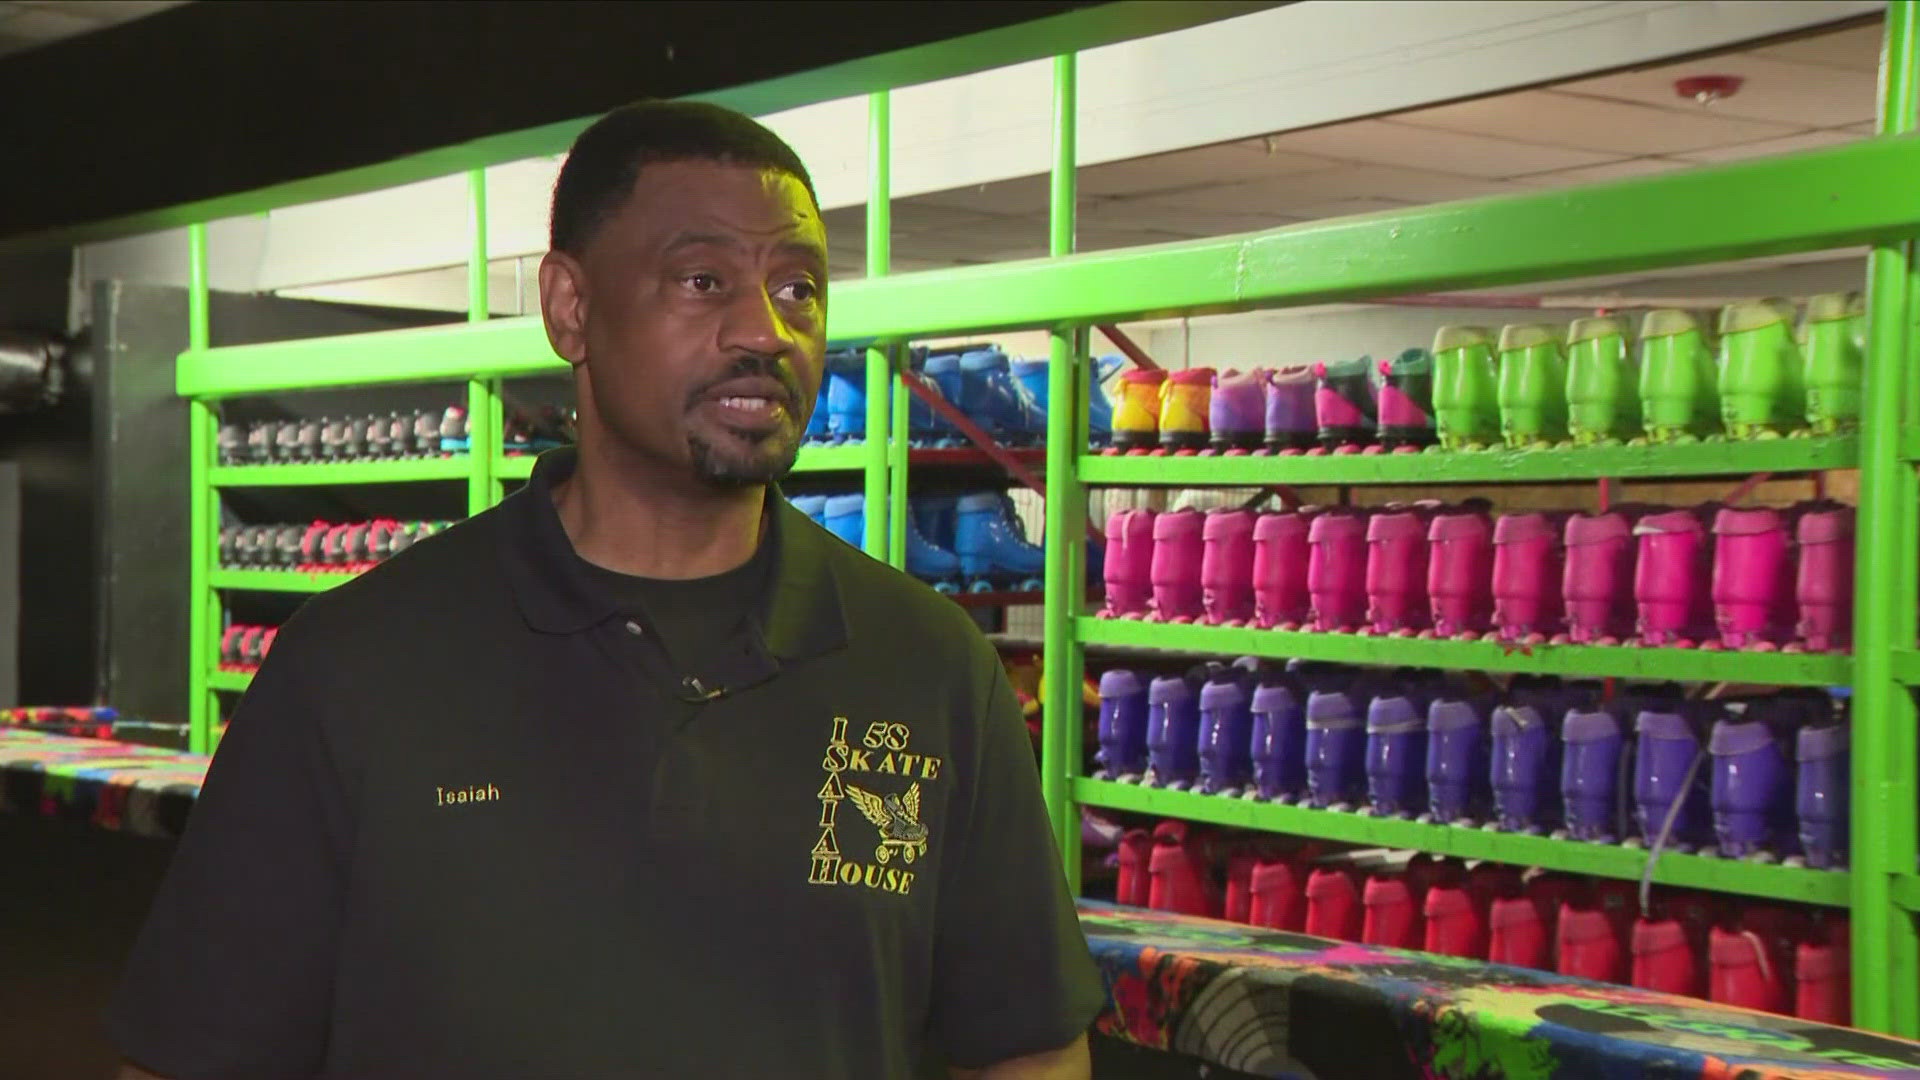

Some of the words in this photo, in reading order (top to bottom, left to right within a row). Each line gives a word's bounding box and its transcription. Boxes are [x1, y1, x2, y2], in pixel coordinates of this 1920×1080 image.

[863, 721, 910, 750] 58
[436, 782, 500, 806] Isaiah
[808, 717, 849, 884] ISAIAH
